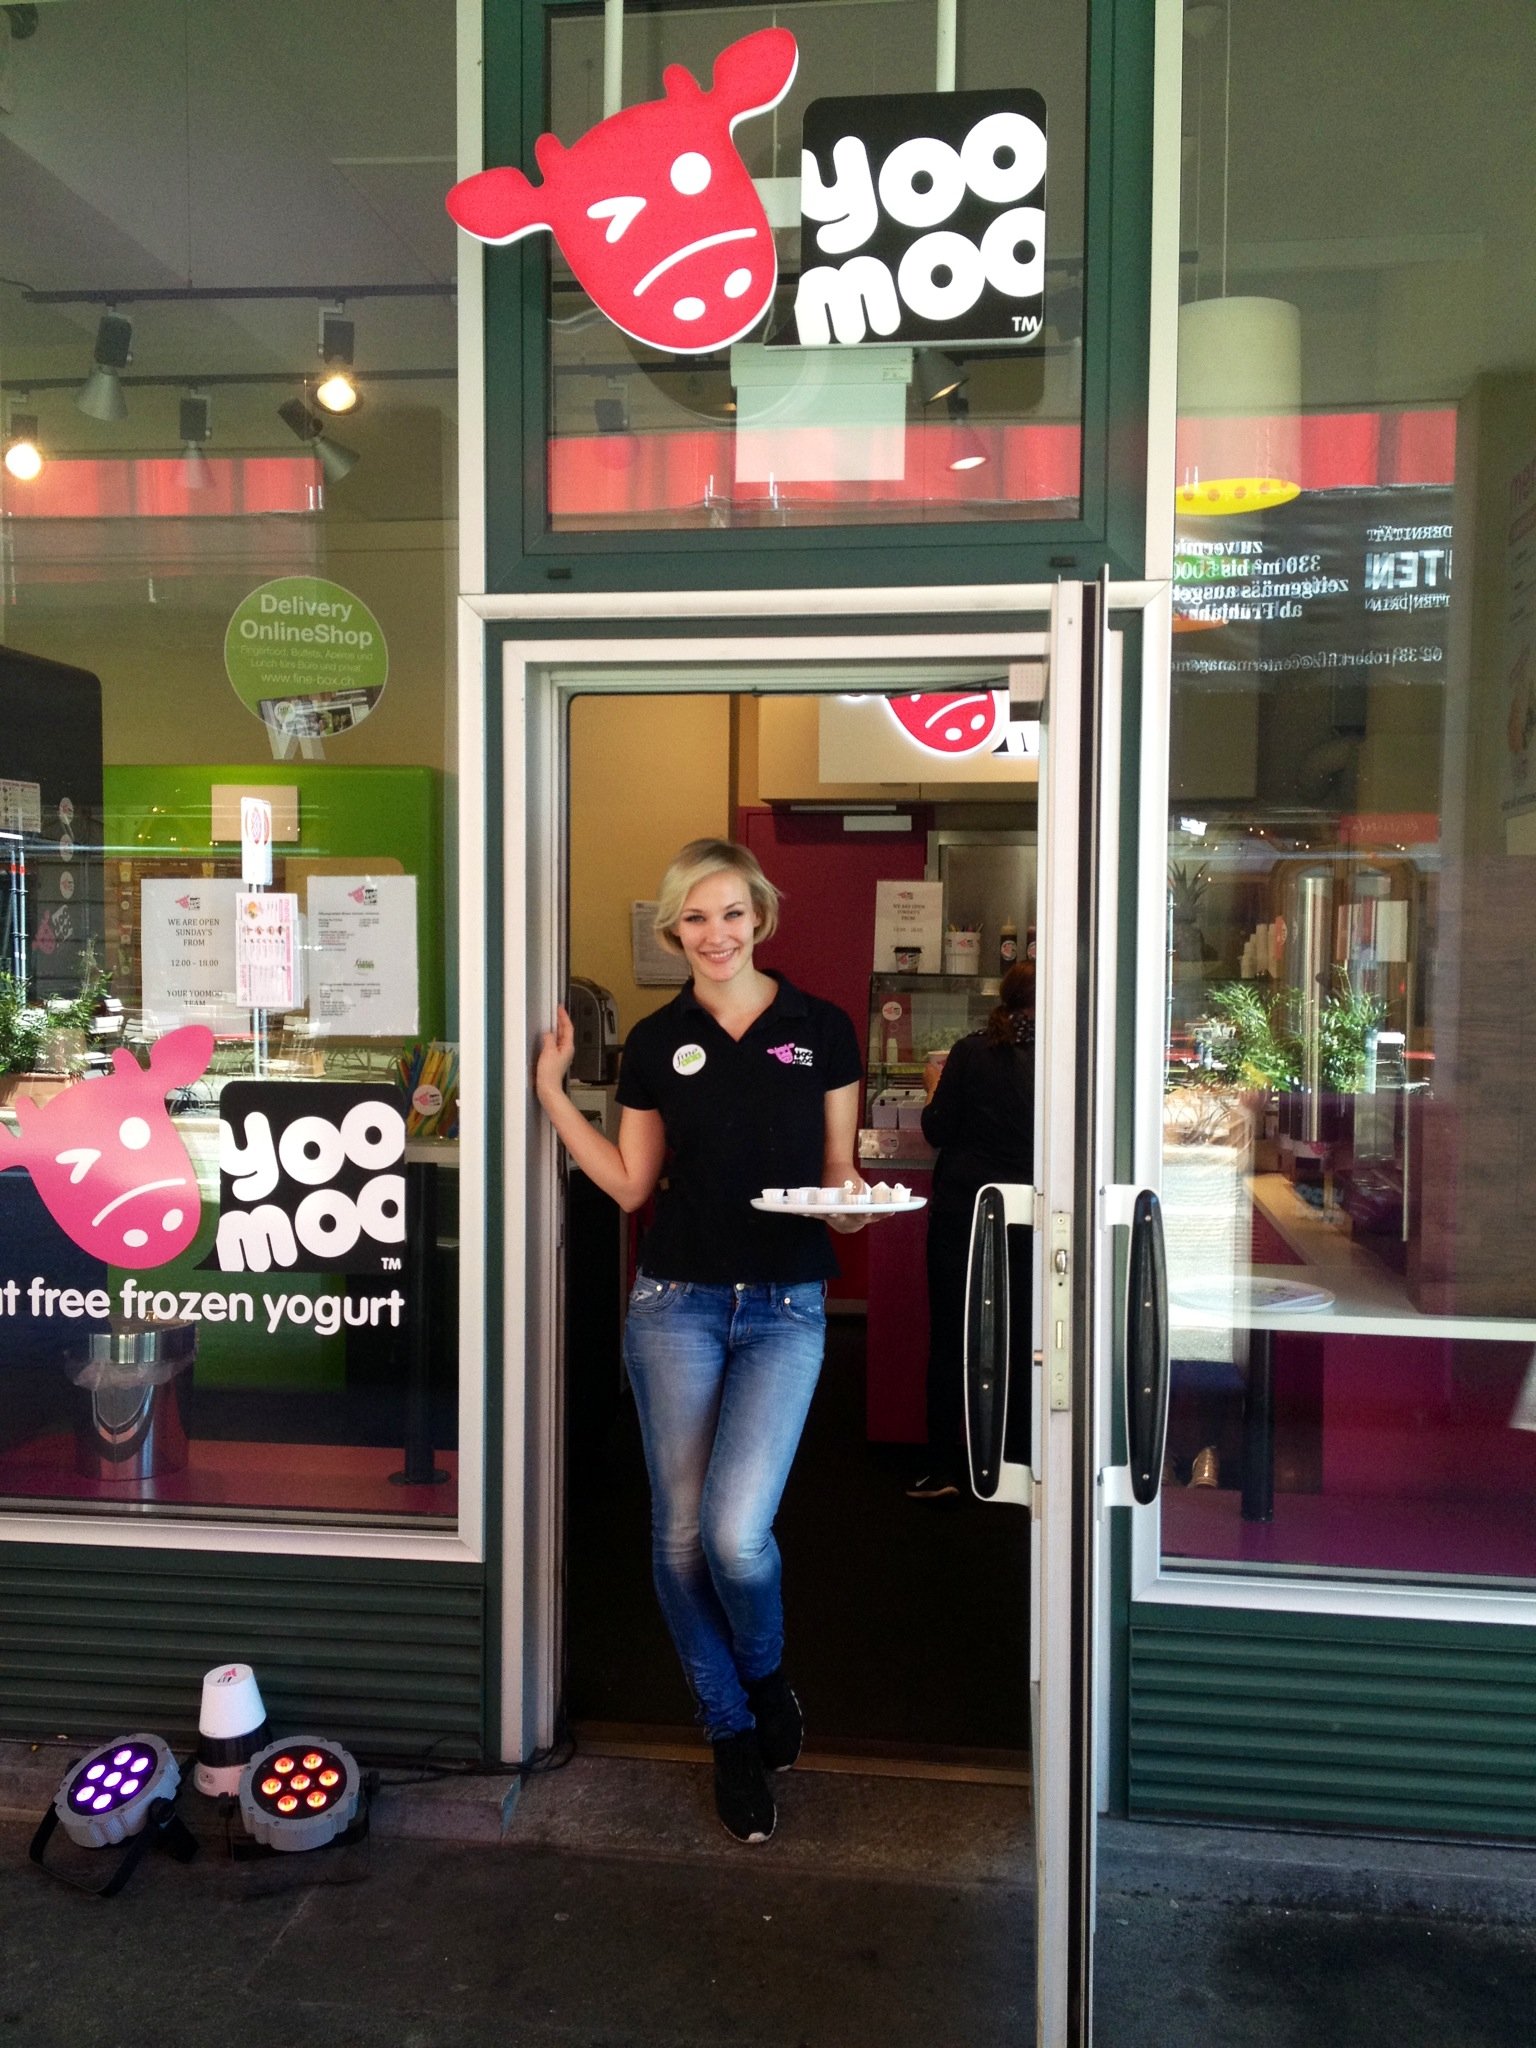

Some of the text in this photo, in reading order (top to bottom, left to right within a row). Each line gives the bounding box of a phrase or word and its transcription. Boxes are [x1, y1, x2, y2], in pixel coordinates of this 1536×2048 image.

[801, 112, 1047, 254] yoo
[1012, 316, 1039, 332] TM
[260, 594, 352, 622] Delivery
[240, 620, 373, 649] OnlineShop
[168, 918, 220, 926] WE ARE OPEN
[219, 1101, 406, 1201] yoo
[381, 1257, 402, 1270] TM
[27, 1277, 110, 1318] free
[119, 1278, 254, 1323] frozen
[263, 1289, 404, 1336] yogurt
